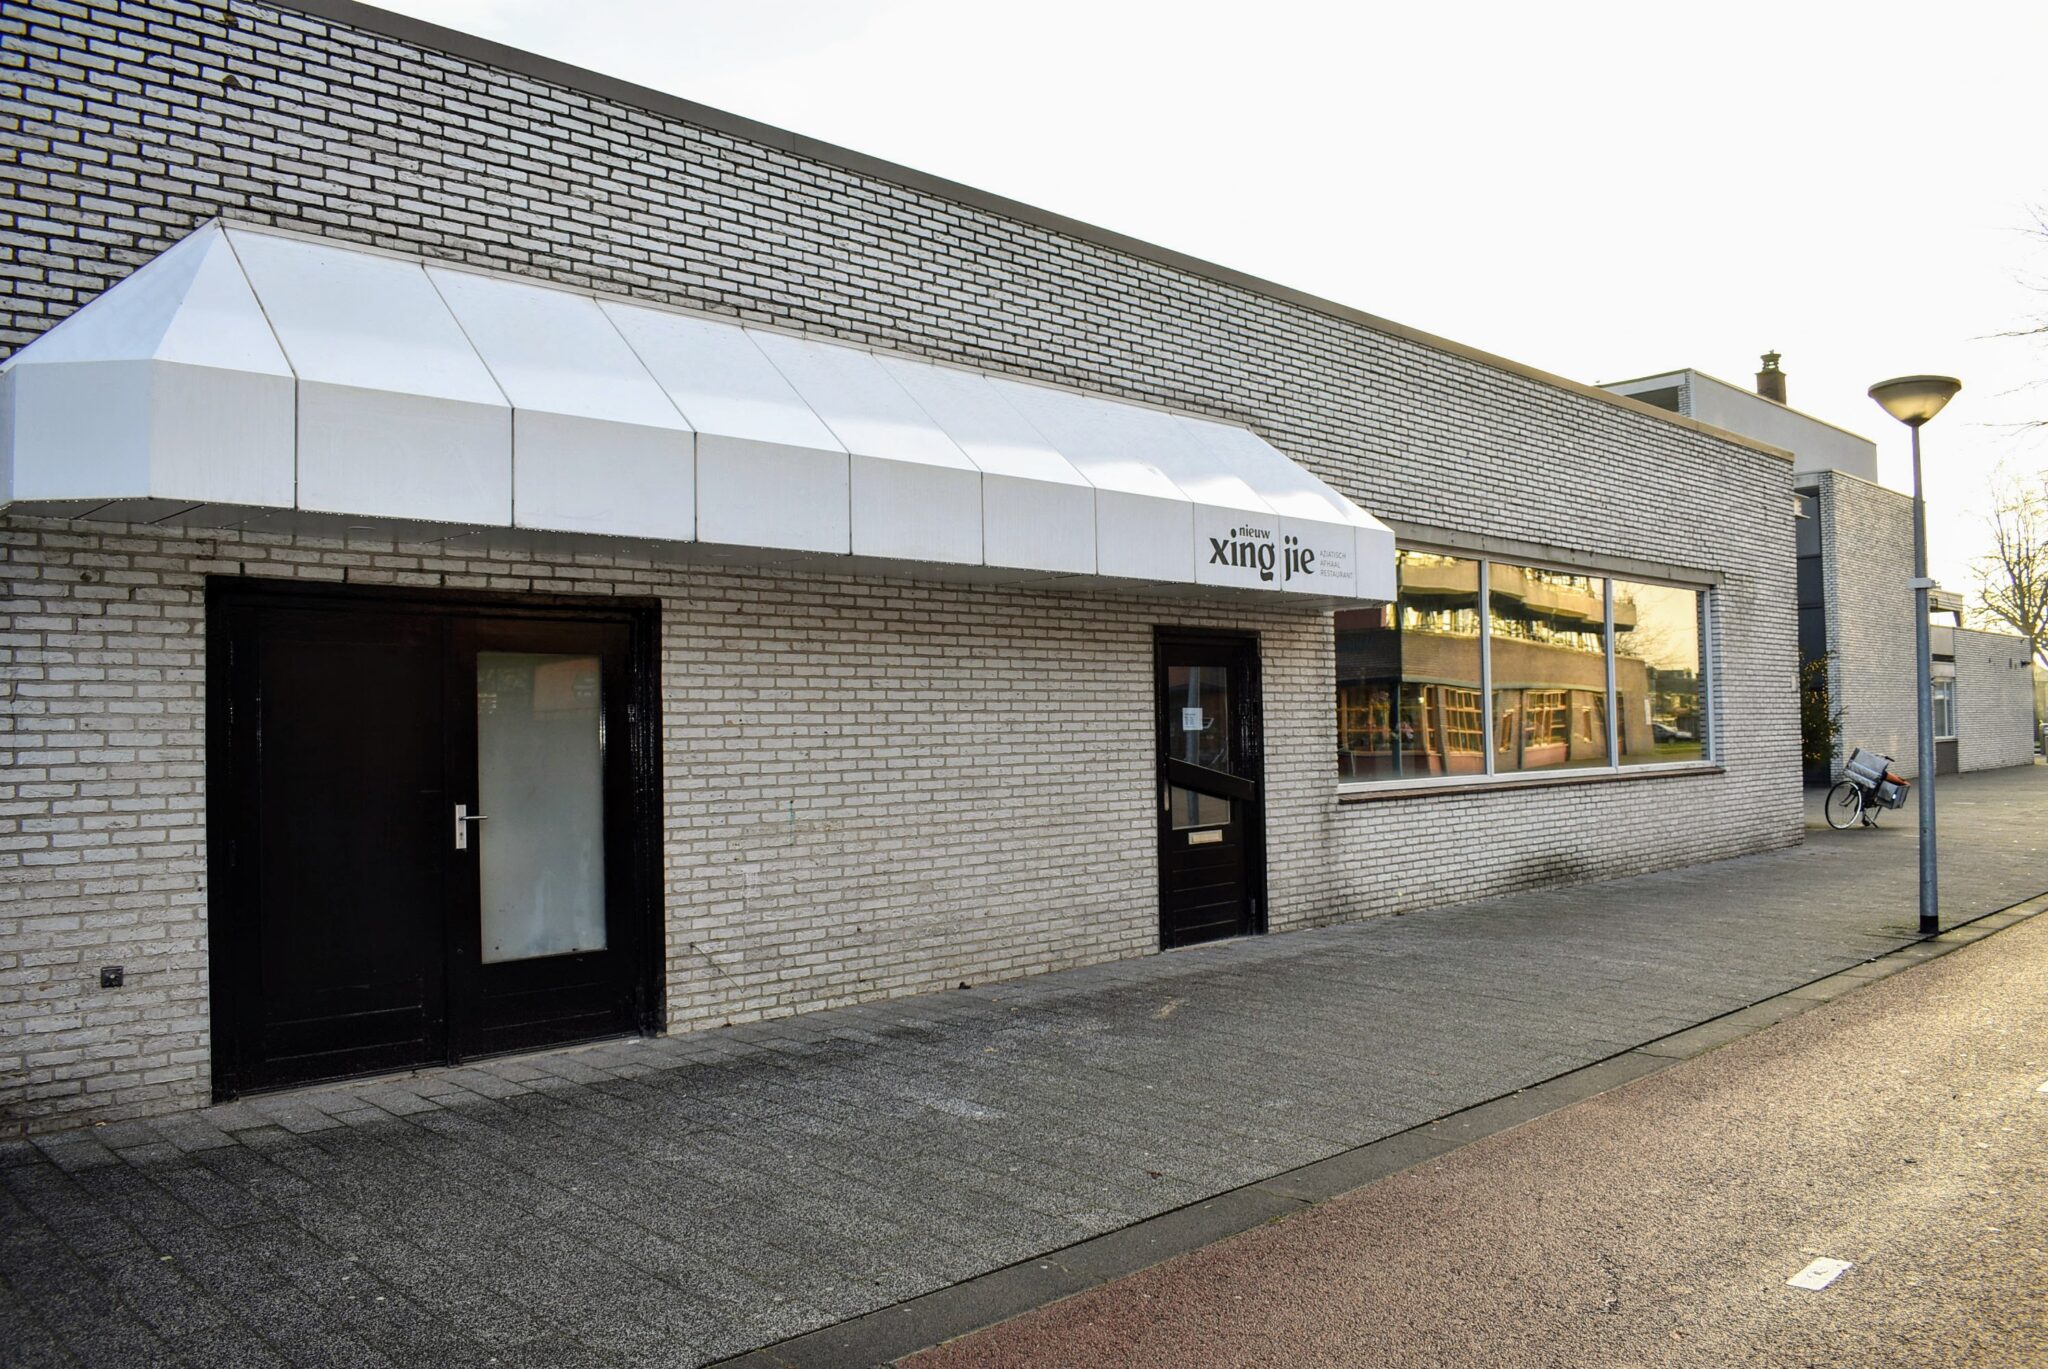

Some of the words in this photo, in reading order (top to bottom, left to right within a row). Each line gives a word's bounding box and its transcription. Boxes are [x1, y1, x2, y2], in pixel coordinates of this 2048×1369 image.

[1239, 524, 1271, 539] nieuw
[1209, 528, 1275, 582] xing
[1284, 535, 1315, 581] jie
[1320, 550, 1347, 559] AZIATISCH
[1320, 560, 1341, 569] AFHAAL
[1320, 569, 1353, 579] RESTAURANT
